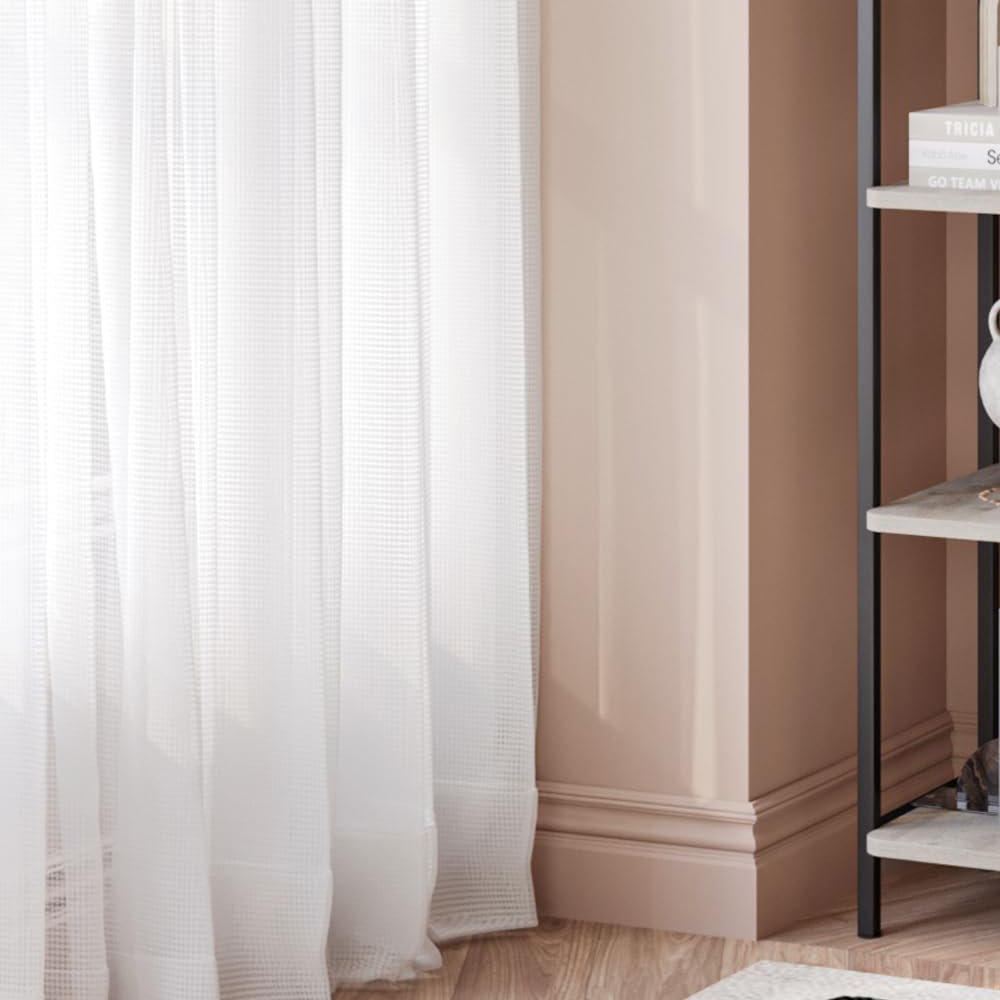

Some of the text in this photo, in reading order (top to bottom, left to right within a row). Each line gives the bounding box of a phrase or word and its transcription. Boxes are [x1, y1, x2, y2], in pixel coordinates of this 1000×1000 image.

[944, 121, 995, 138] TRICIA
[928, 176, 947, 189] GO
[950, 177, 987, 191] TEAM
